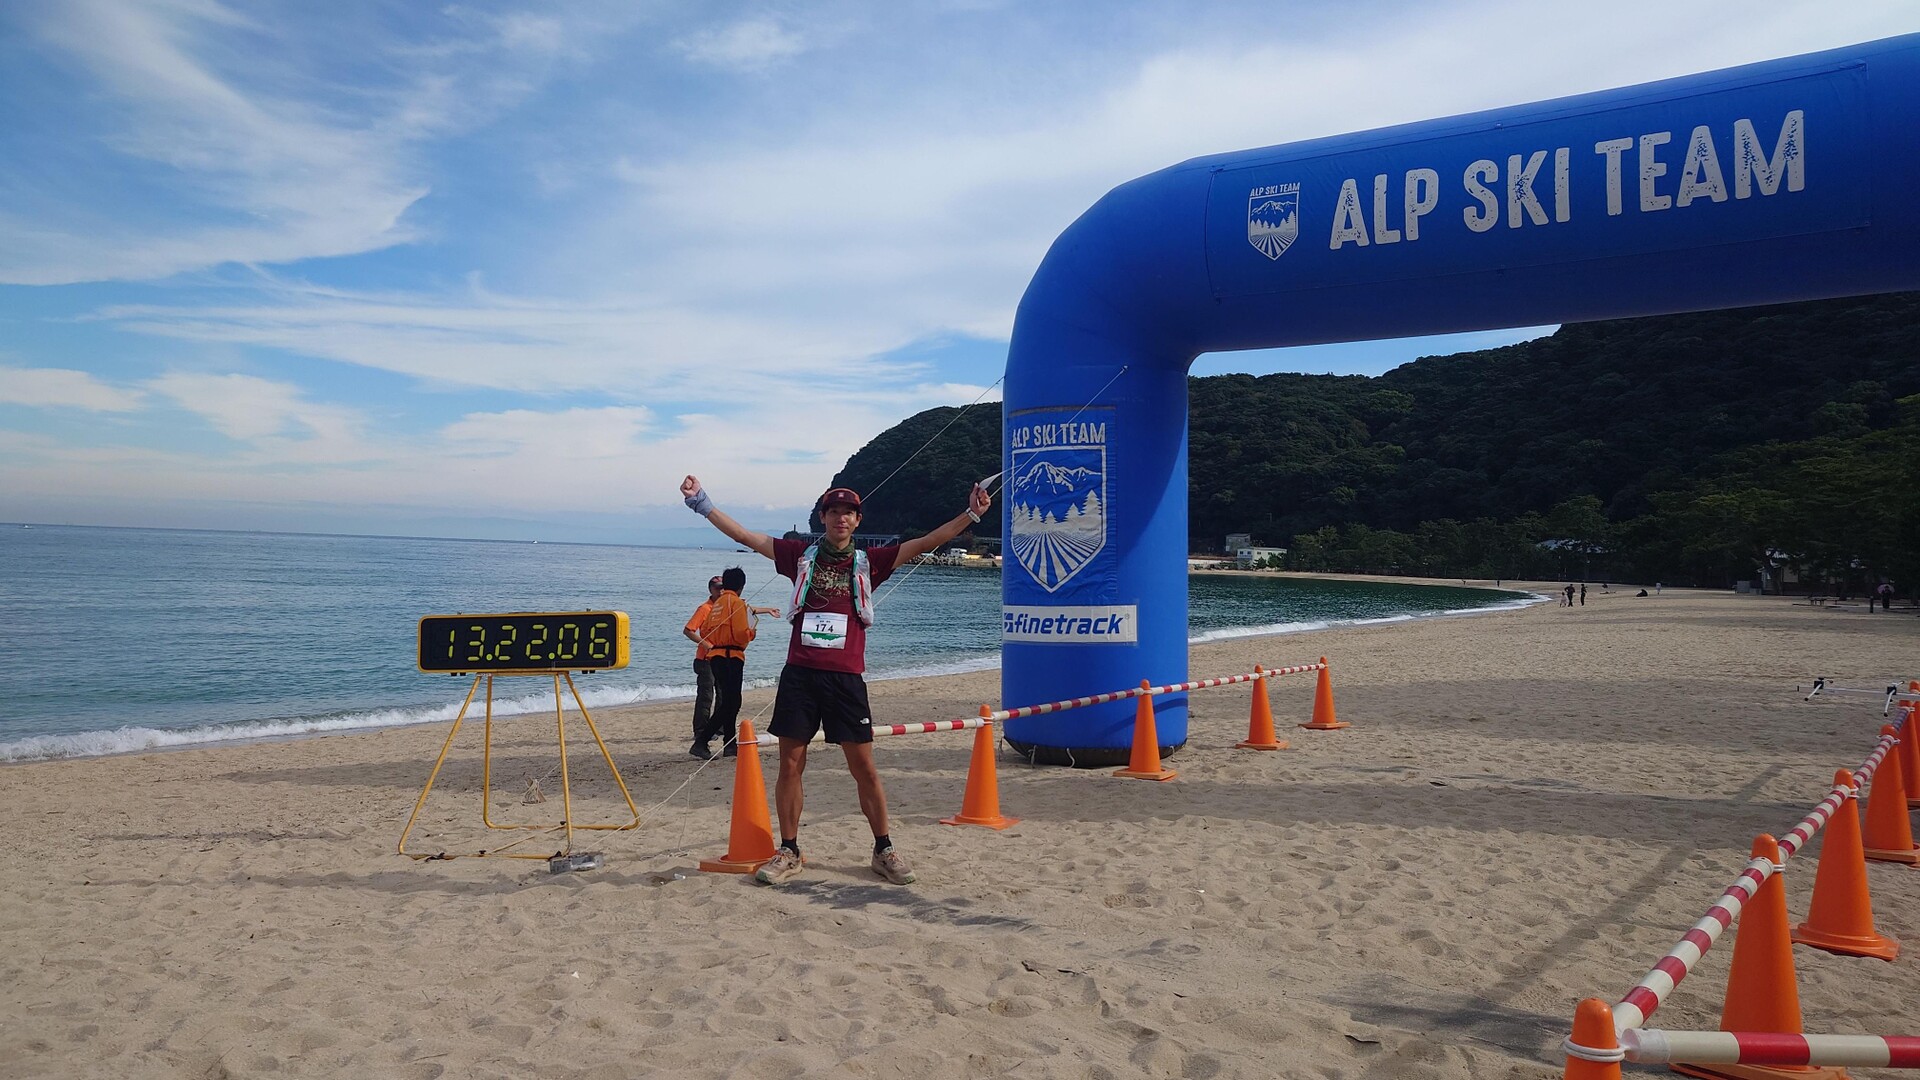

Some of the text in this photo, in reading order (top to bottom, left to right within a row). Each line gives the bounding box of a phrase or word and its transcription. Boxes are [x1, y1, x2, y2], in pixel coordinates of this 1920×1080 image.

[1250, 182, 1300, 197] ALP SKI TEAM
[1329, 109, 1805, 250] ALP SKI TEAM
[1011, 422, 1106, 448] ALP SKI TEAM
[815, 624, 834, 633] 174
[1014, 613, 1124, 635] finetrack
